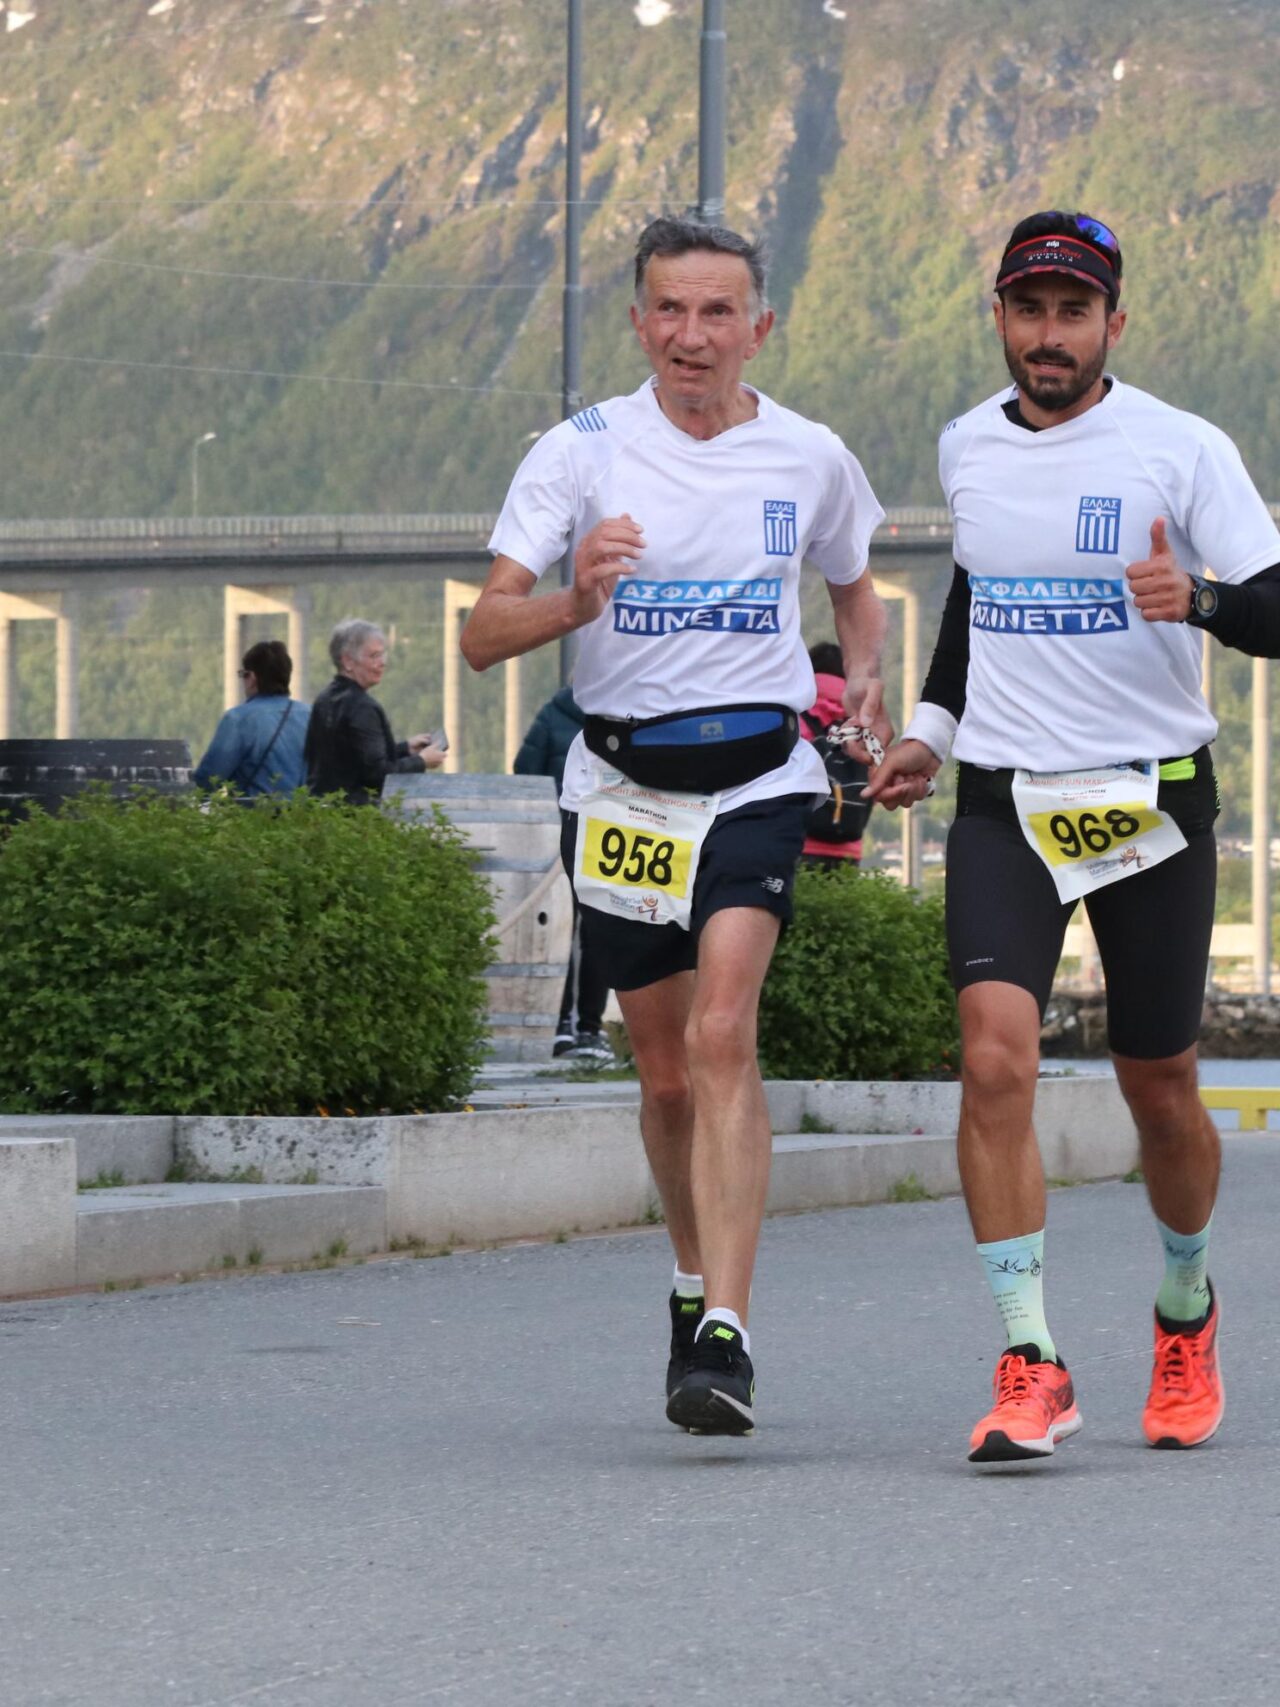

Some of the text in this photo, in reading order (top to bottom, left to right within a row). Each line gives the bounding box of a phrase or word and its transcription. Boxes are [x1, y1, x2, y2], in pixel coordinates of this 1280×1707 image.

[618, 606, 776, 633] MINETTA
[974, 604, 1123, 631] MINETTA
[628, 805, 668, 821] MARATHON
[1048, 808, 1140, 858] 968
[598, 827, 675, 886] 958
